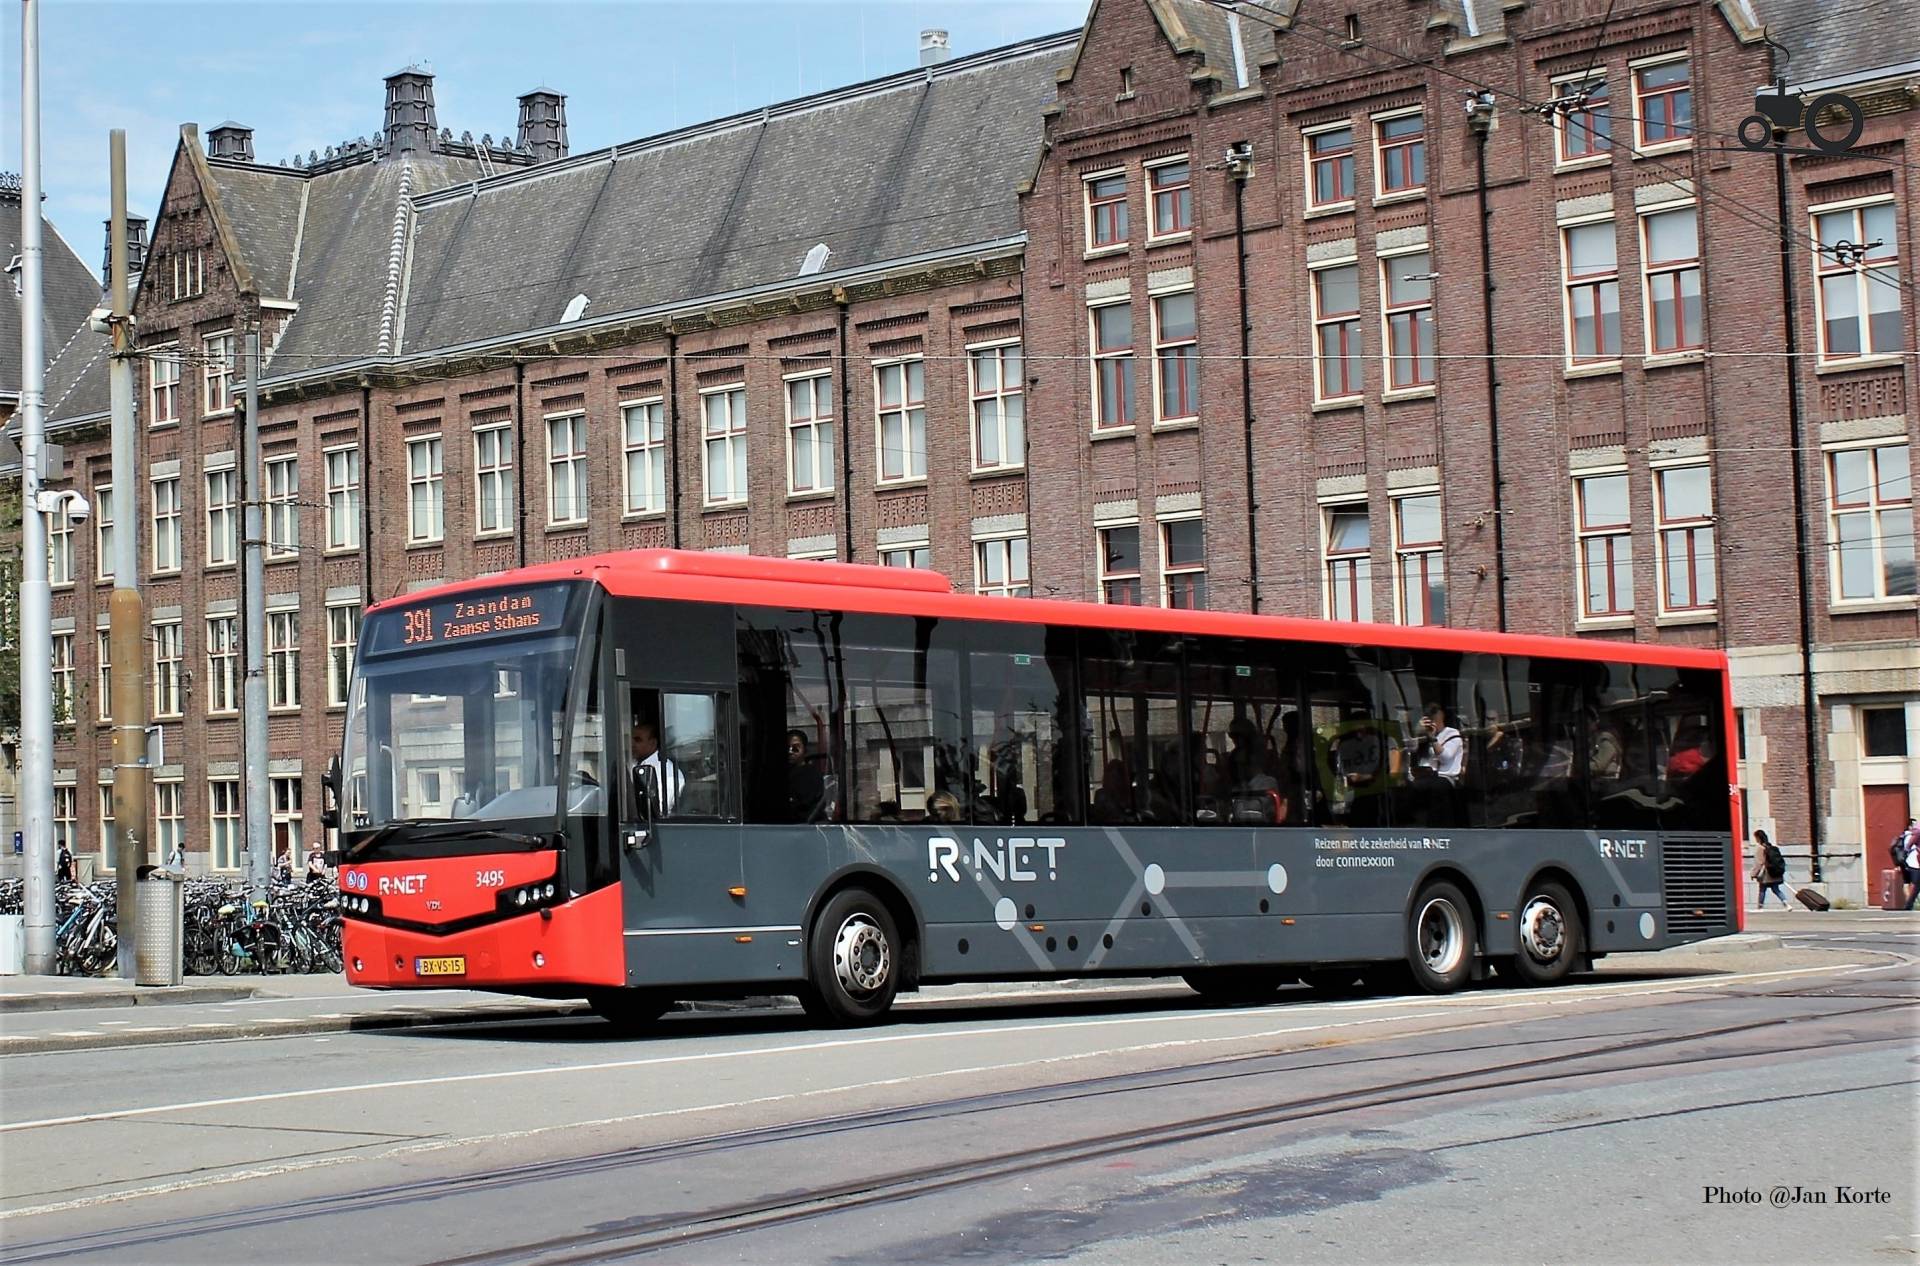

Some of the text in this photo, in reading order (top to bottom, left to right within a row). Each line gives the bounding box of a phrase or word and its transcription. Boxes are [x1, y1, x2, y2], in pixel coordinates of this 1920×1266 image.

[455, 596, 532, 619] Zaandam
[403, 608, 434, 644] 391
[444, 612, 540, 639] Zaanse Schans
[1314, 838, 1340, 849] Reizen
[1342, 838, 1358, 850] met
[1359, 838, 1370, 849] de
[1371, 838, 1408, 850] zekerheid
[1409, 840, 1423, 849] van
[1316, 856, 1395, 868] door connexxion
[475, 870, 505, 888] 3495
